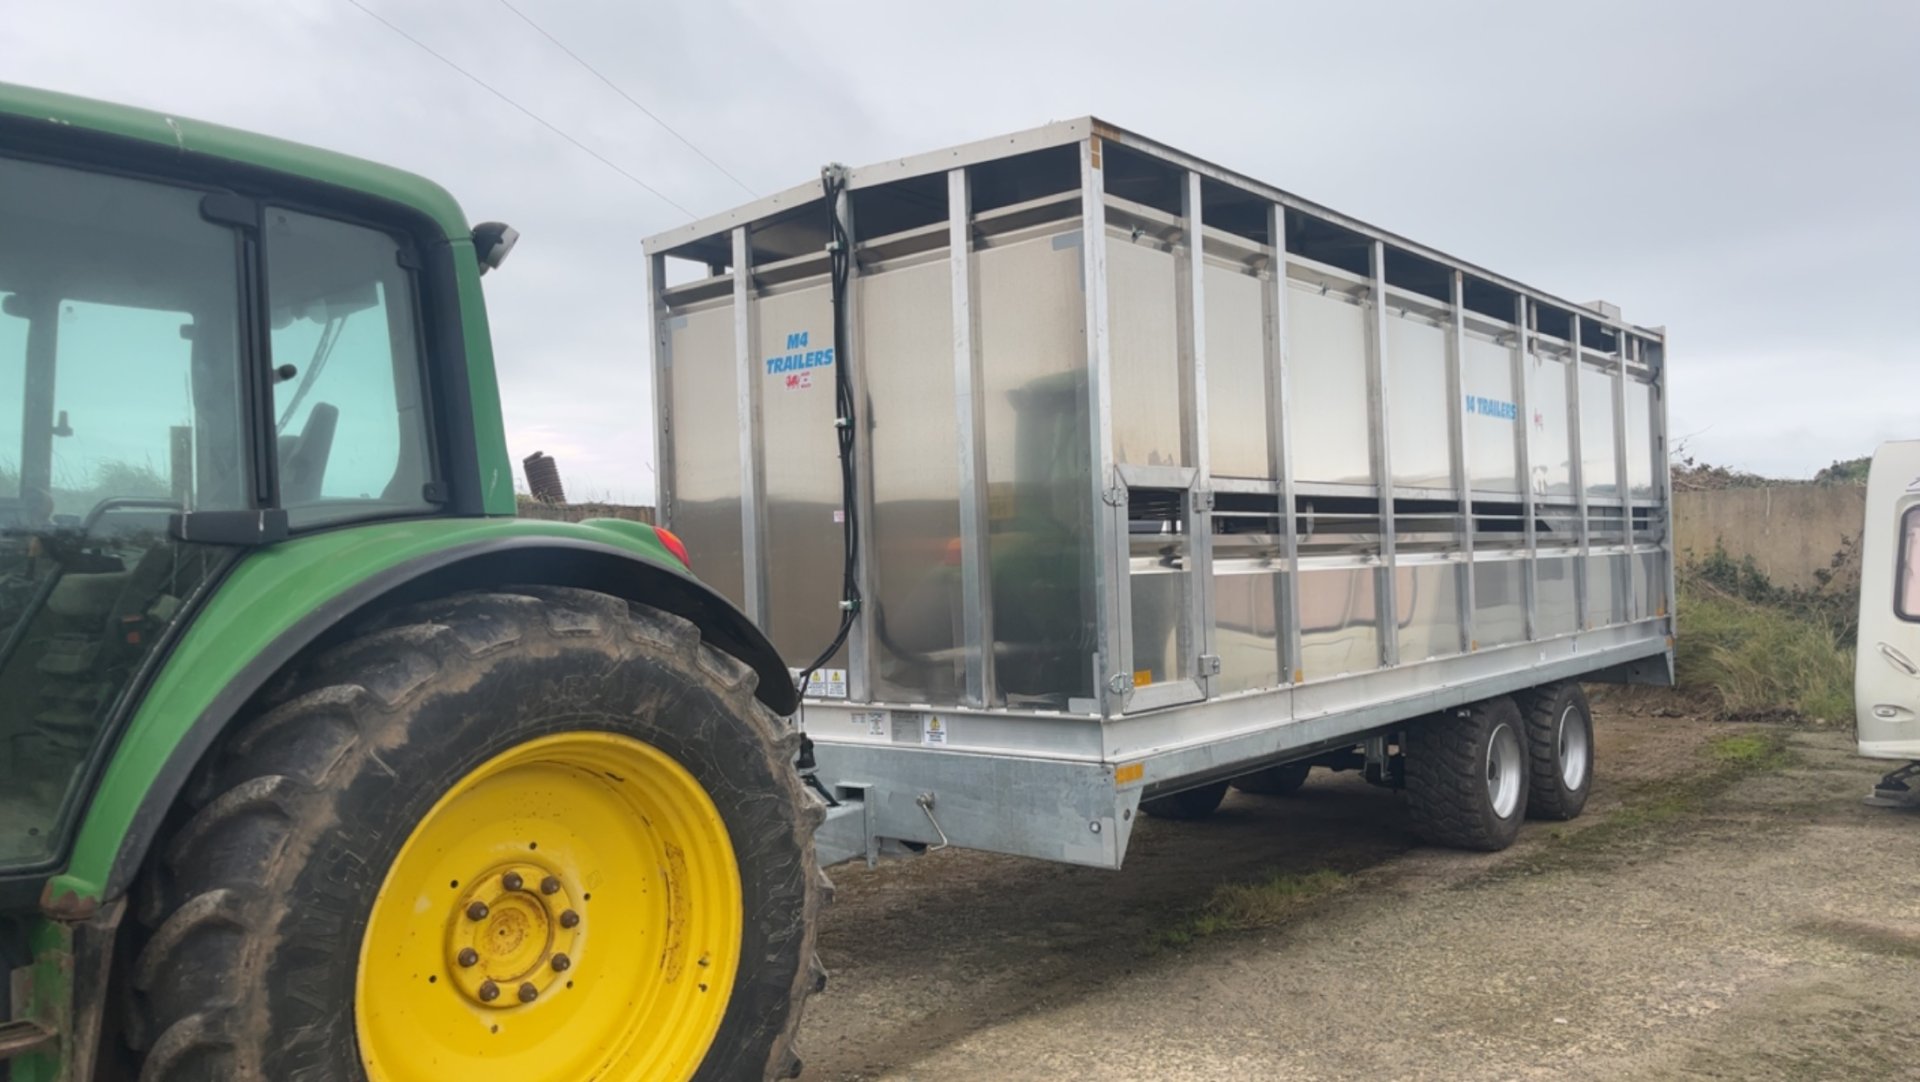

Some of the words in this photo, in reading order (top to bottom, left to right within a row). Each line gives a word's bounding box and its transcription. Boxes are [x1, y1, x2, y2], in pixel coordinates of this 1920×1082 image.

[786, 331, 808, 350] M4
[766, 348, 834, 374] TRAILERS
[1477, 396, 1516, 420] TRAILERS
